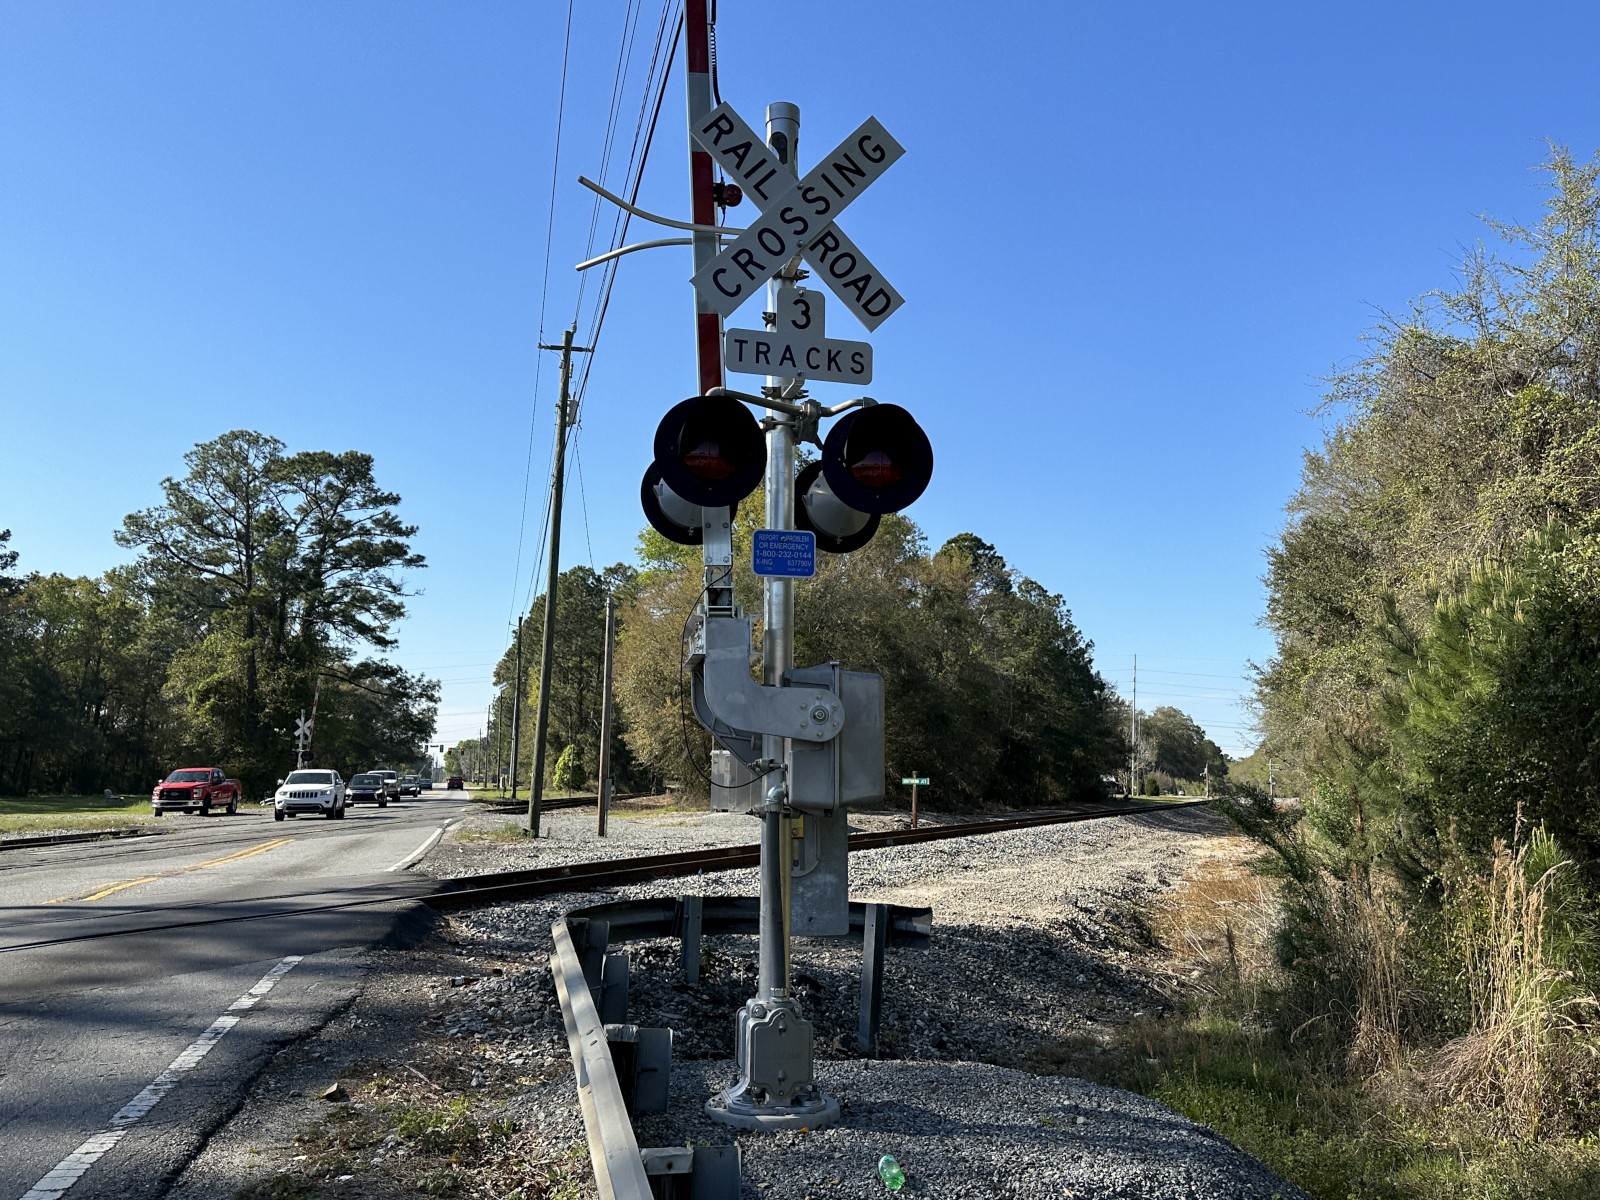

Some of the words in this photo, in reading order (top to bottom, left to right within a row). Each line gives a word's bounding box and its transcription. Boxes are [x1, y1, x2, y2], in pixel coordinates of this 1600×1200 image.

[702, 113, 777, 201] RAIL
[808, 231, 891, 318] ROAD
[712, 135, 886, 298] CROSSING
[791, 299, 811, 330] 3
[734, 339, 865, 375] TRACKS
[756, 550, 811, 558] 1-800-232-0144
[756, 558, 773, 566] X-ING
